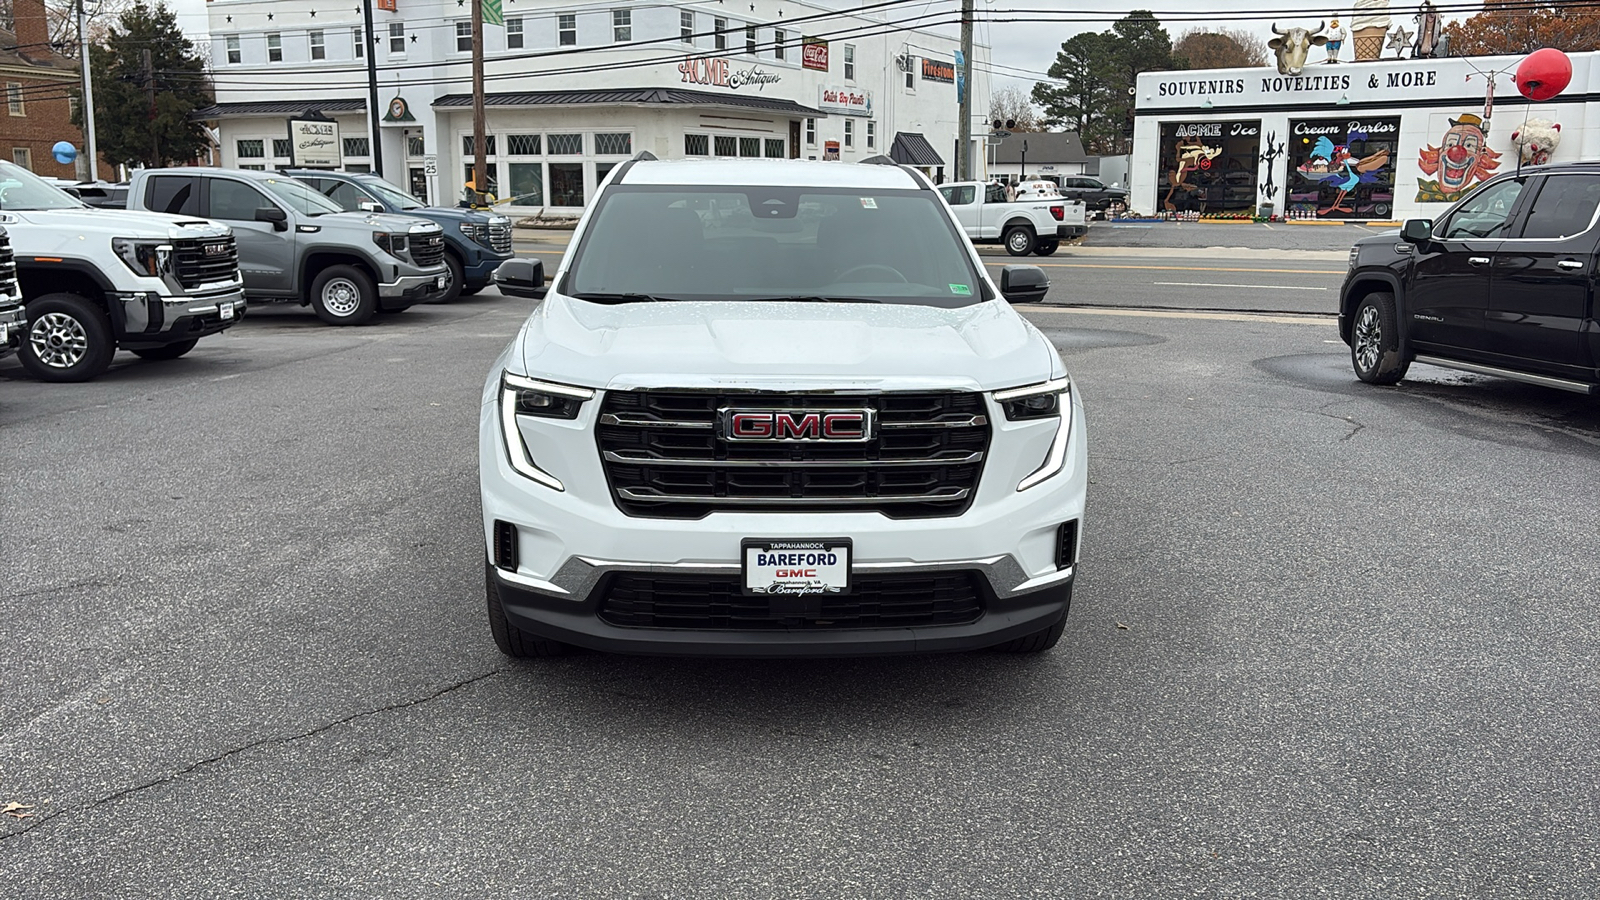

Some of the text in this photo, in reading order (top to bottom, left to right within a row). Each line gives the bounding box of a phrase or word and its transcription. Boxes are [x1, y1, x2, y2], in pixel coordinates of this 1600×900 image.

[804, 44, 826, 63] Coca-Cola
[678, 55, 781, 91] ACME Antiques
[922, 60, 954, 80] Firestone
[1159, 71, 1436, 96] SOUVENIRS NOVELTIES & MORE
[824, 90, 864, 106] Dutch Boy Paints
[1176, 121, 1397, 137] ACME Ice Cream Parlor
[426, 166, 436, 174] 25
[1414, 314, 1444, 322] DENALI
[732, 413, 864, 438] GMC
[757, 553, 837, 566] BAREFORD
[776, 569, 816, 578] GMC
[767, 584, 828, 597] Bareford
